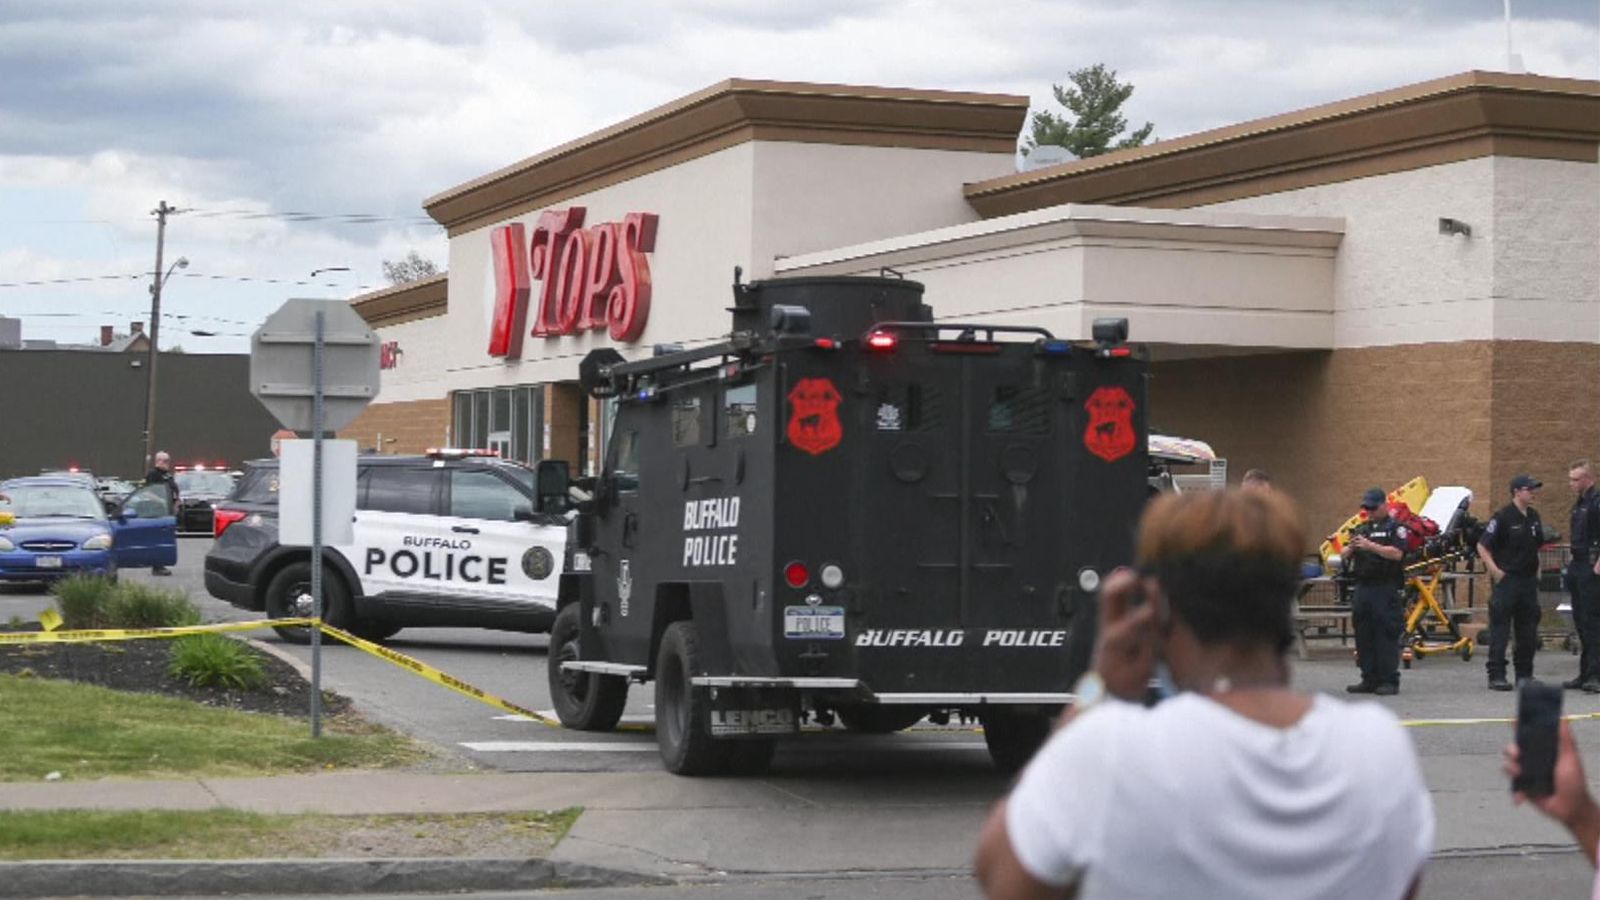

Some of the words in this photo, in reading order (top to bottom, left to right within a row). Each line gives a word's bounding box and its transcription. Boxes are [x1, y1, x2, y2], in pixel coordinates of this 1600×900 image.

[684, 497, 739, 529] BUFFALO
[403, 536, 470, 550] BUFFALO
[683, 535, 737, 566] POLICE
[365, 548, 507, 584] POLICE
[797, 618, 831, 631] POLICE
[856, 629, 965, 646] BUFFALO
[983, 630, 1065, 646] POLICE
